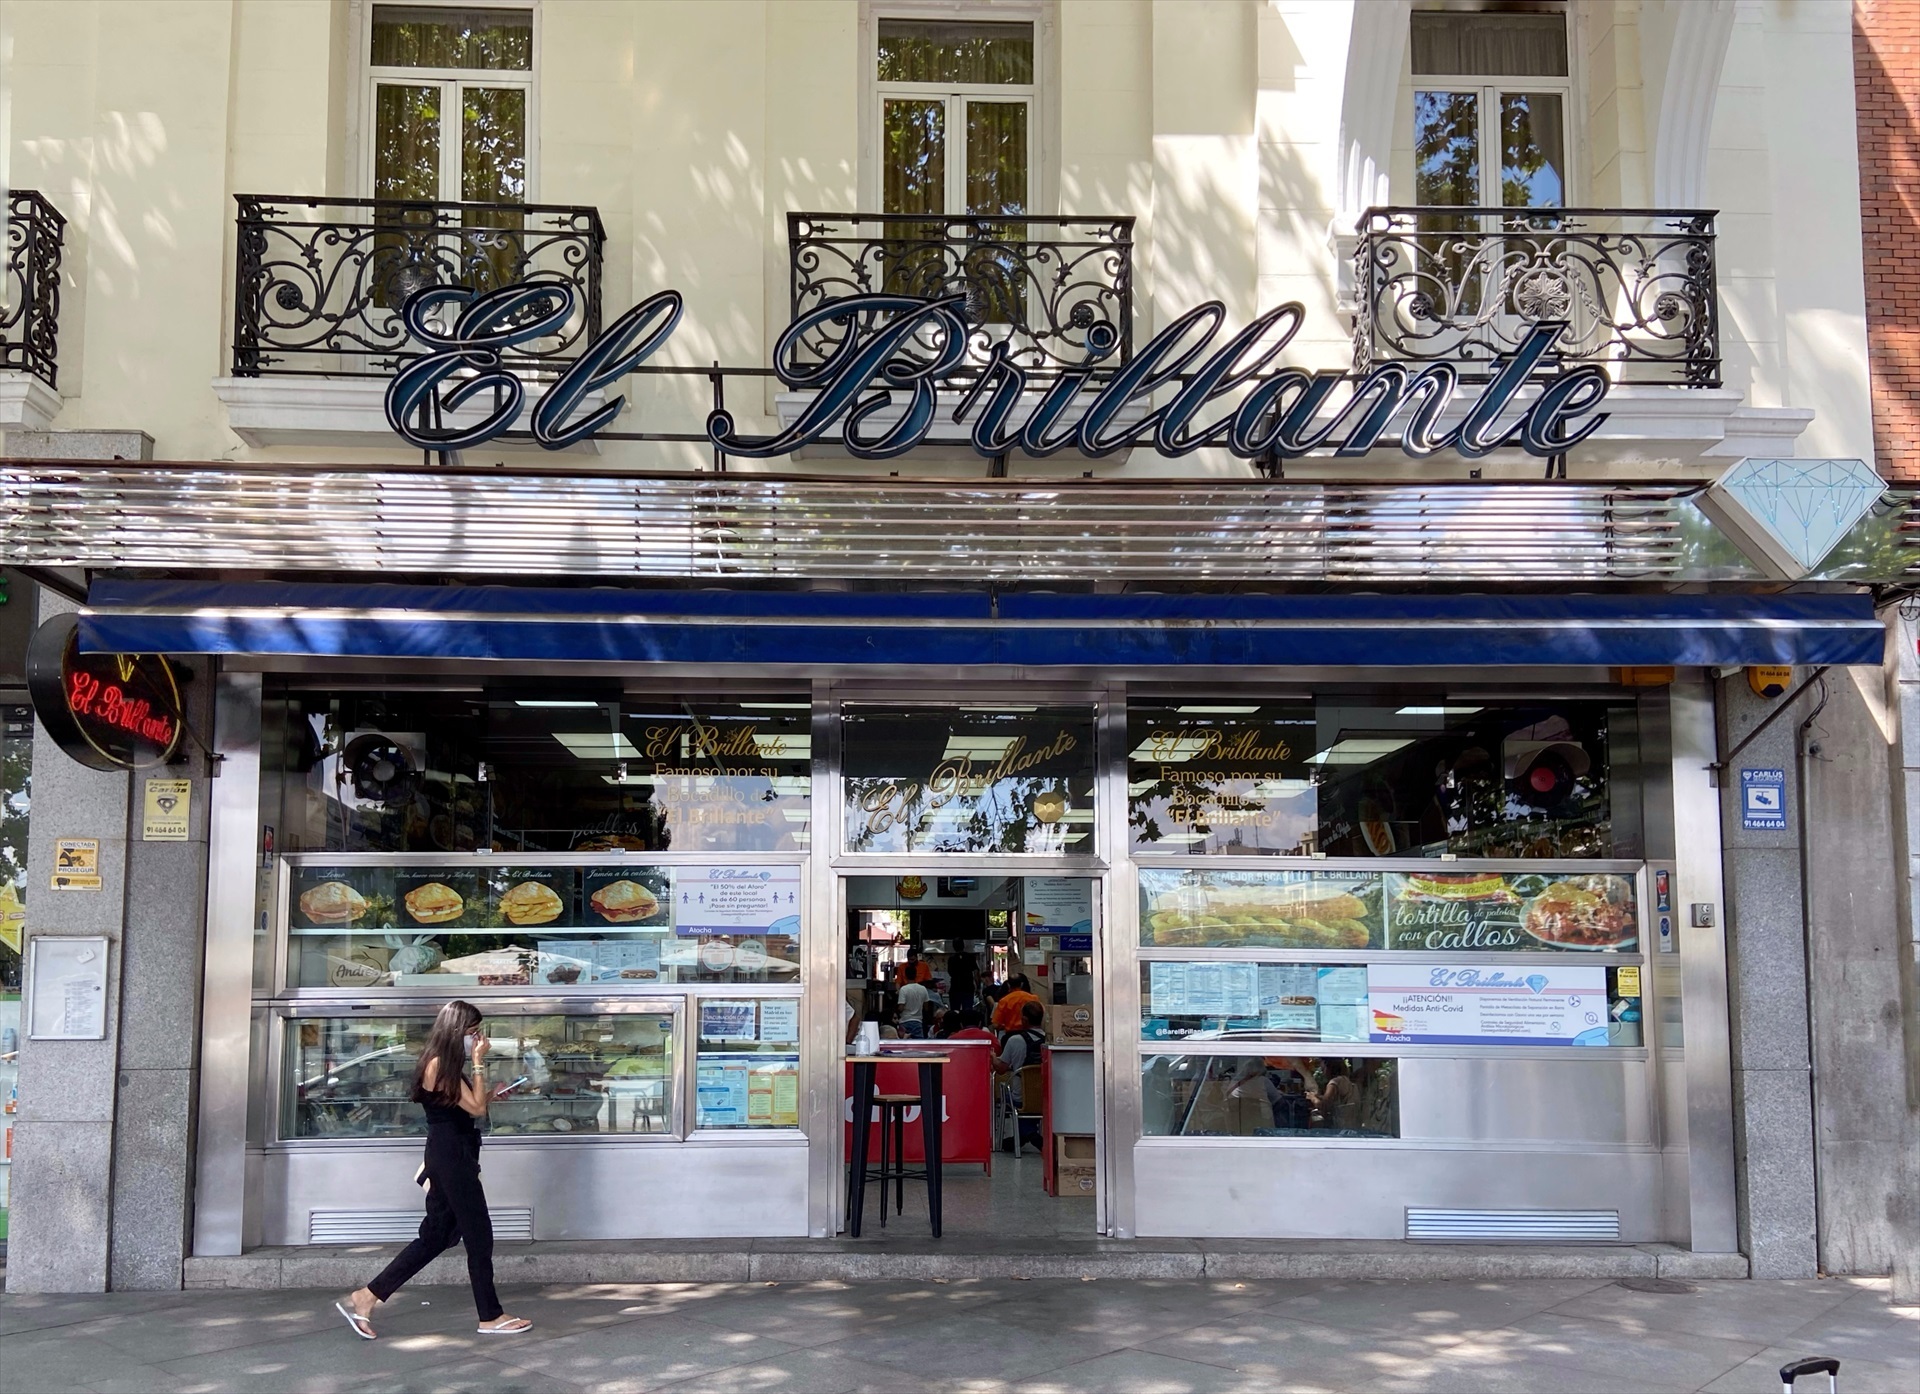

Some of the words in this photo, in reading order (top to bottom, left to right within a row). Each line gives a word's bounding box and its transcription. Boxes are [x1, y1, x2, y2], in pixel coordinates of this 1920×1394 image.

[384, 281, 684, 452] El
[706, 292, 1610, 459] Brillante
[71, 672, 99, 714] El
[95, 686, 172, 744] Brillante
[645, 725, 682, 760] El
[685, 724, 787, 756] Brillante
[1151, 730, 1187, 764] El
[1190, 729, 1291, 760] Brillante
[655, 763, 720, 778] Famoso
[726, 767, 755, 782] por
[760, 767, 778, 778] su
[1160, 766, 1225, 782] Famoso
[1231, 772, 1259, 786] por
[1264, 772, 1282, 783] su
[863, 783, 918, 834] El
[929, 729, 1077, 808] Brillante
[667, 786, 744, 802] Bocadillo
[568, 813, 641, 849] paellas
[511, 870, 520, 878] El
[522, 870, 552, 878] Brillante
[586, 869, 613, 879] Jamón
[620, 869, 629, 877] la
[709, 868, 722, 879] El
[722, 868, 759, 879] Brillante
[1222, 872, 1254, 880] MEJOR
[1395, 902, 1473, 926] tortilla
[1474, 908, 1484, 917] de
[1399, 931, 1422, 941] con
[1430, 968, 1456, 986] El
[1455, 969, 1525, 987] Brillante
[1403, 994, 1453, 1003] ¡¡ATENCIÓN!!
[1393, 1004, 1424, 1012] Medidas
[1156, 1028, 1206, 1036] @BarelBrillant
[1385, 1034, 1411, 1042] Atocha
